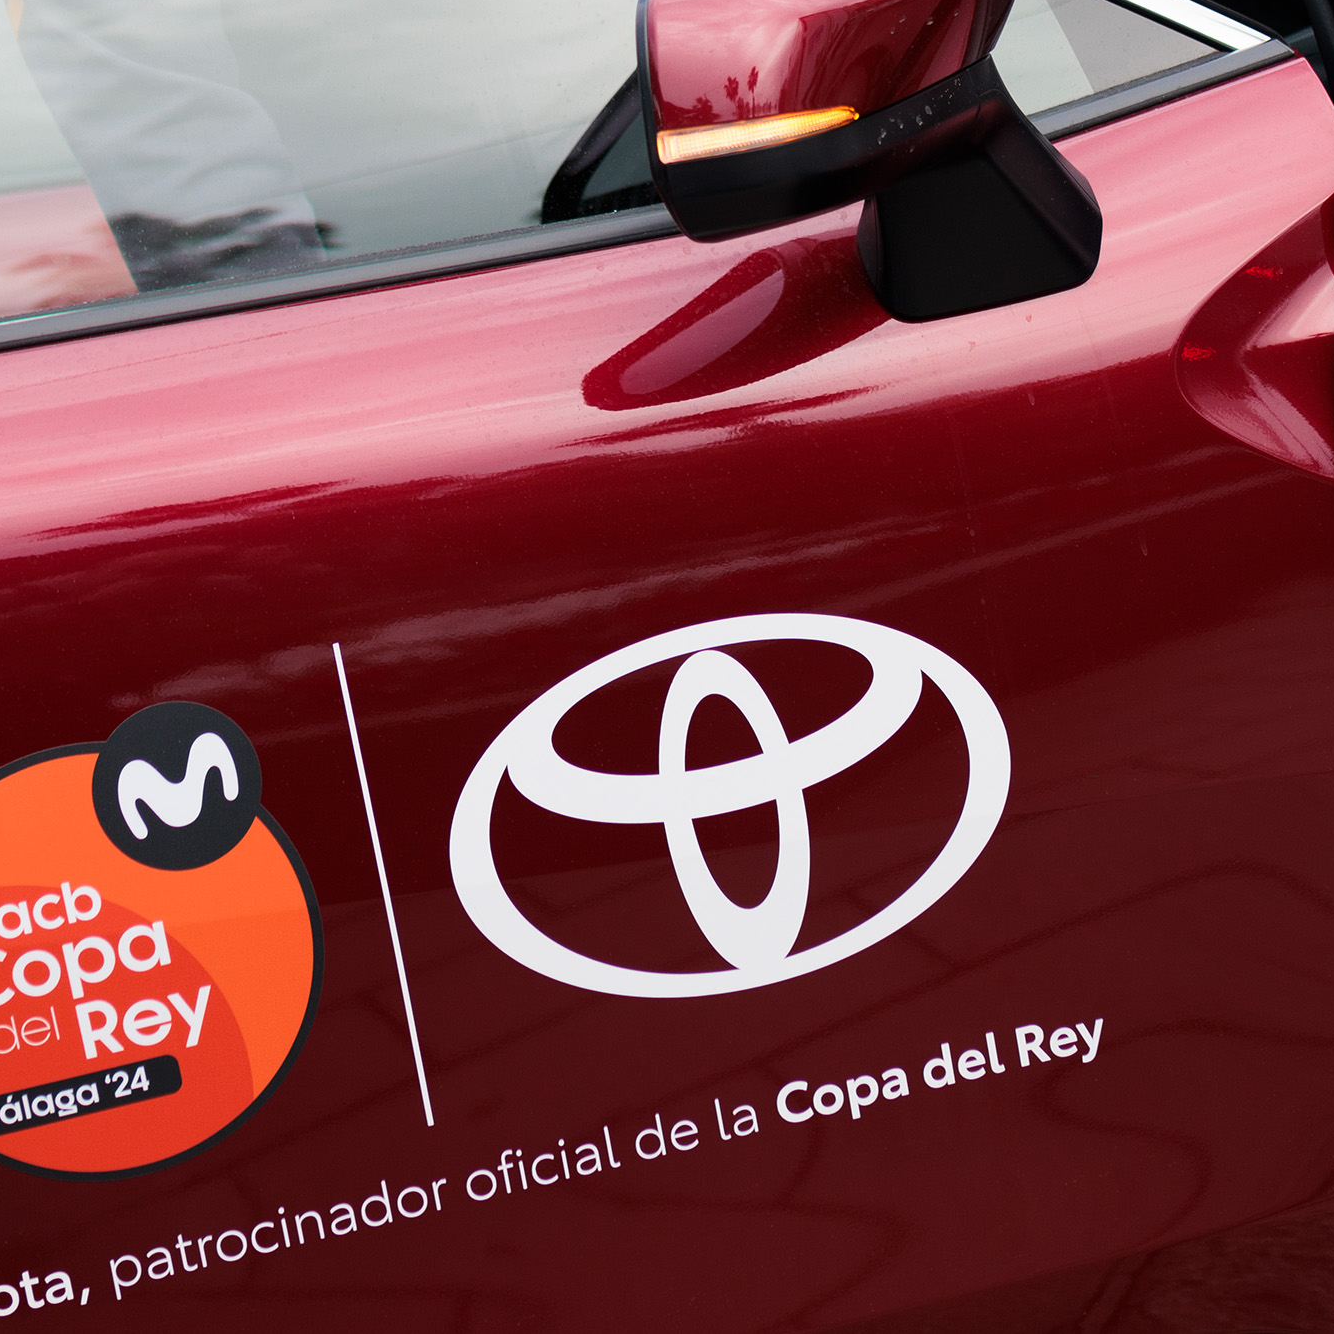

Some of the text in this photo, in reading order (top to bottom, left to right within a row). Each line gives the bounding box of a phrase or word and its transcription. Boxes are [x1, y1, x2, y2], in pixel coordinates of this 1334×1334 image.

[74, 985, 212, 1060] Rey
[109, 1178, 447, 1301] patrocinador
[466, 1125, 621, 1201] oficial
[635, 1113, 699, 1160] de
[714, 1098, 760, 1141] la
[776, 1067, 910, 1123] Copa
[923, 1031, 1006, 1089] del
[1014, 1018, 1104, 1068] Rey
